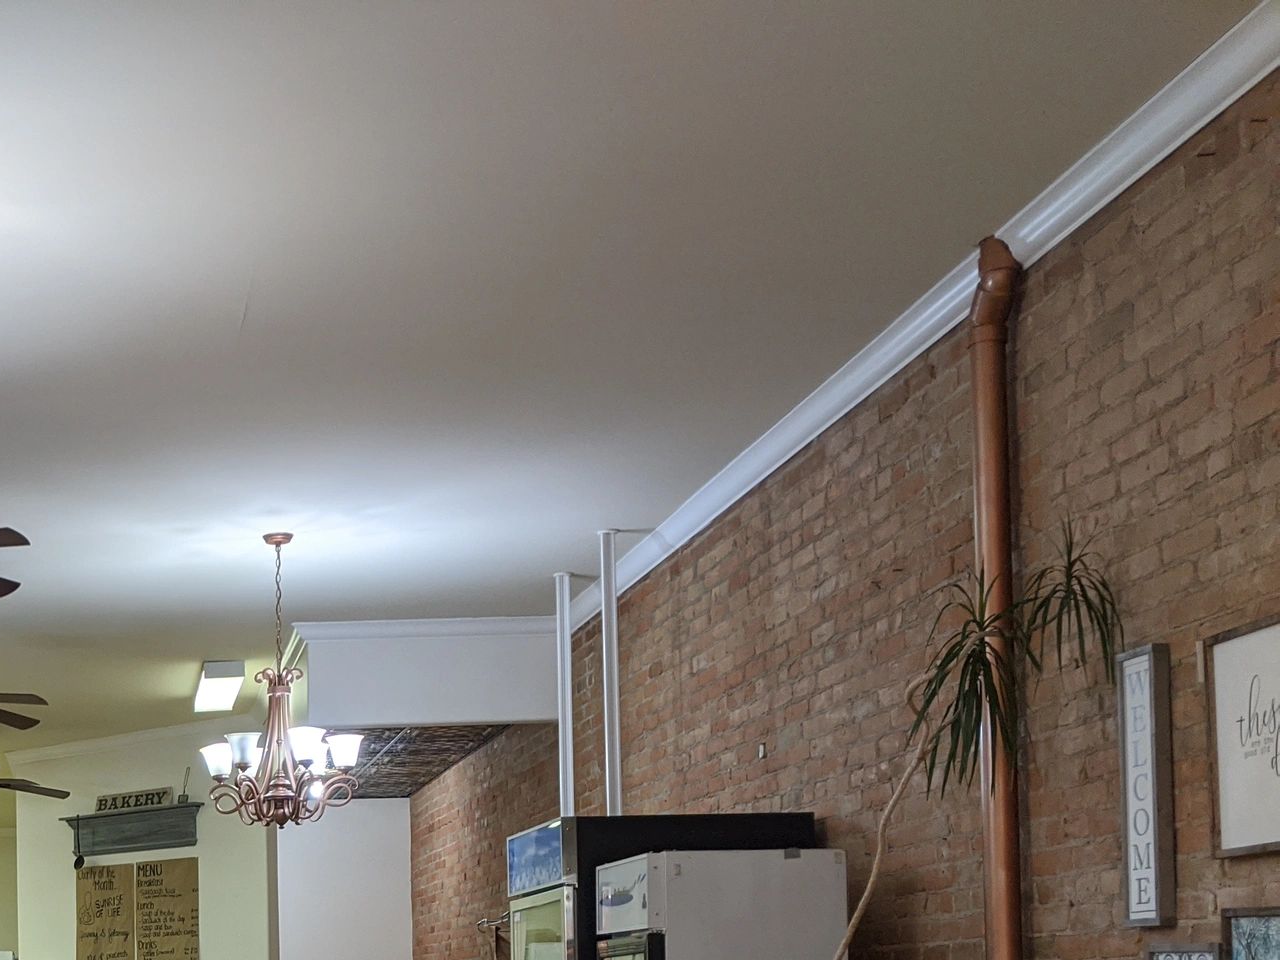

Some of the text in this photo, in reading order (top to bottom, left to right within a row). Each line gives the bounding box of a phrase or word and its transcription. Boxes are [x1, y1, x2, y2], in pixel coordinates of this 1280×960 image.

[1236, 674, 1280, 747] thes
[1127, 669, 1152, 906] WELCOME
[96, 791, 168, 811] BAKERY
[137, 863, 163, 877] MENU
[95, 894, 124, 909] SUNRISE
[136, 901, 155, 910] Lunch
[96, 906, 121, 918] OF LIFE
